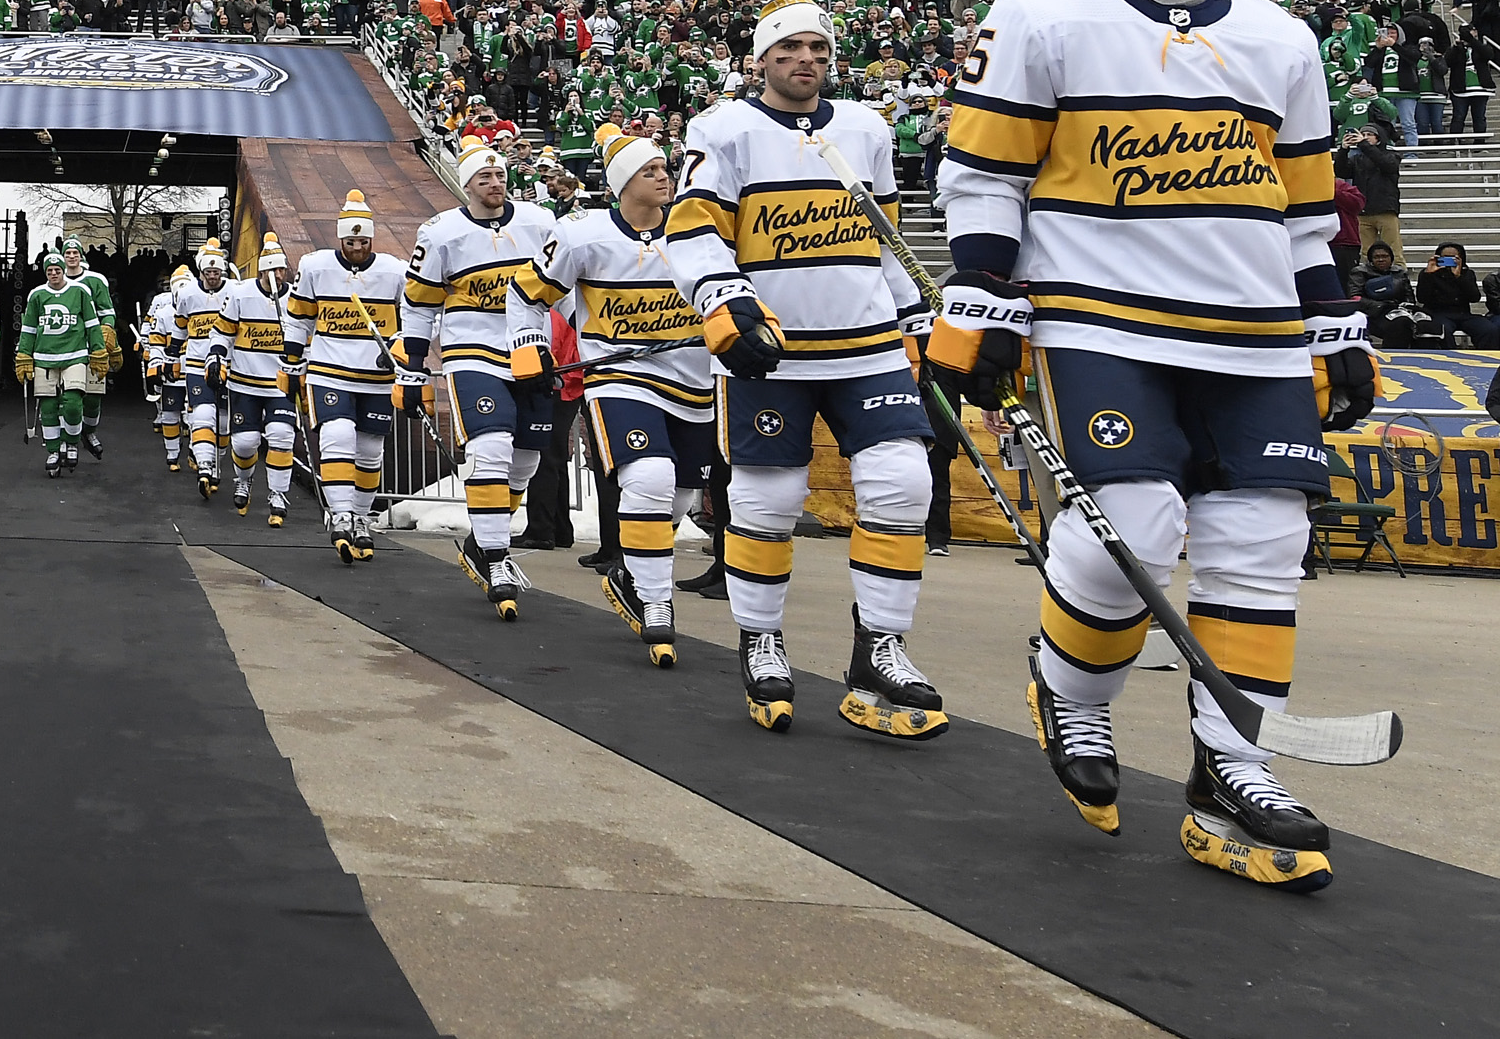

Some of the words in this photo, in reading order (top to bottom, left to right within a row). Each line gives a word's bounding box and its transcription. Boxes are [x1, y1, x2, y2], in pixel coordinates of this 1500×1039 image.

[18, 68, 198, 81] BRIDGESTONE
[1089, 119, 1256, 168] Nashville
[1112, 154, 1278, 207] Predators
[752, 196, 866, 235] Nashville
[599, 288, 690, 319] Nashville
[947, 299, 1036, 328] BAUER
[862, 393, 922, 410] CCM
